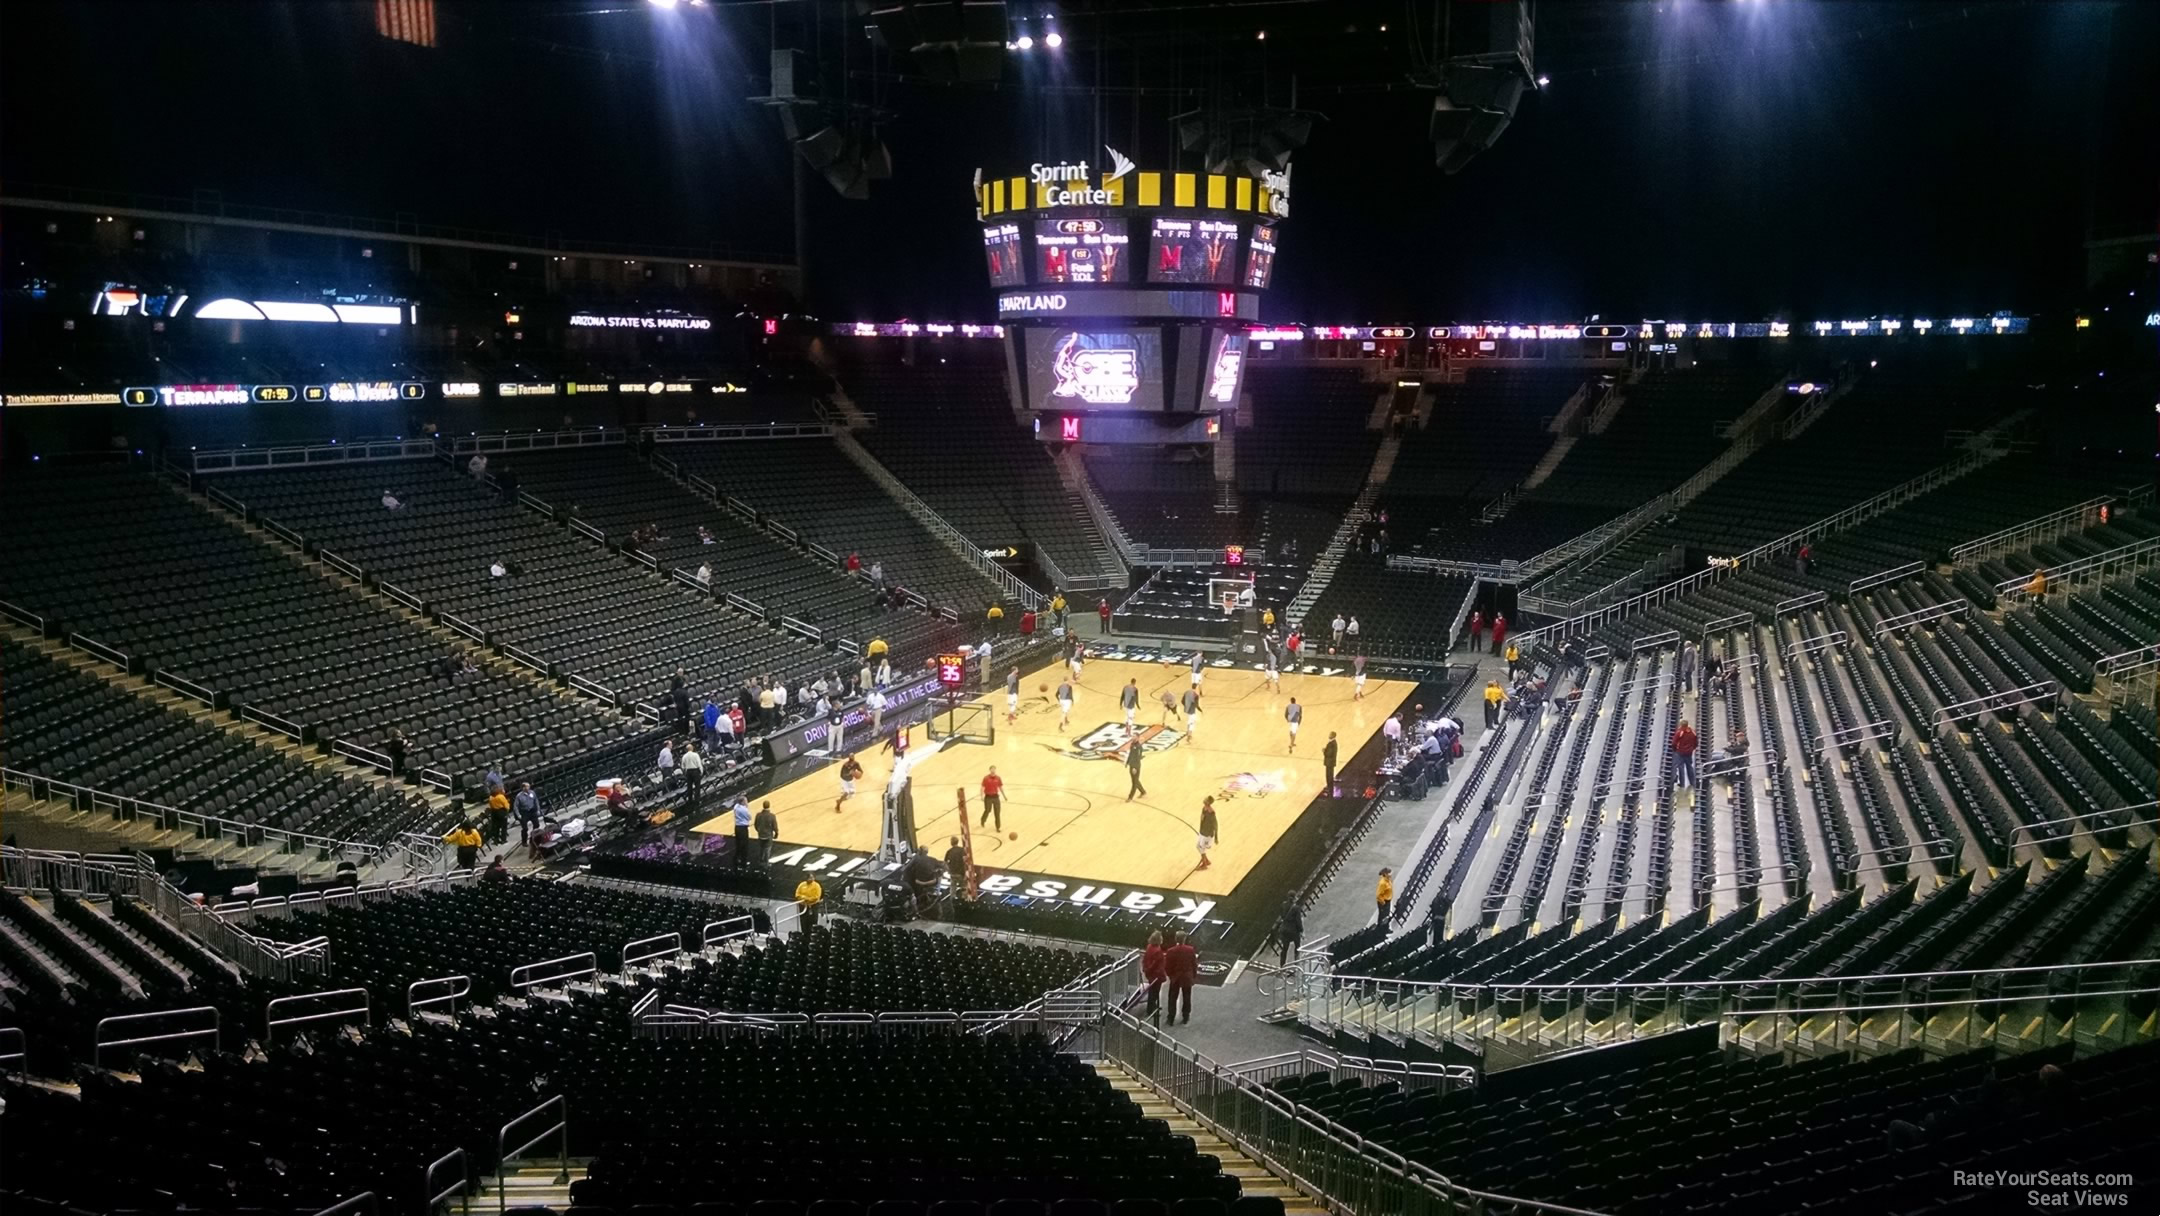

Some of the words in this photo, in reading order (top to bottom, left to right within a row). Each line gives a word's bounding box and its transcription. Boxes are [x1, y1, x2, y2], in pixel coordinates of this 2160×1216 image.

[1031, 161, 1089, 187] Sprint
[1046, 185, 1115, 206] Center
[1003, 294, 1067, 311] MARYLAND
[1221, 293, 1234, 314] M
[570, 316, 607, 327] ARIZONA
[607, 317, 640, 328] STATE
[641, 318, 657, 328] VS.
[657, 319, 711, 330] MARYLAND
[136, 391, 145, 403] 0
[261, 388, 289, 400] 47:59
[409, 386, 416, 397] 0
[518, 384, 556, 395] Farmland
[1063, 418, 1079, 437] M
[983, 549, 1007, 559] Sprint
[1707, 555, 1730, 567] Sprint
[943, 664, 960, 681] 35
[804, 723, 831, 744] DRIV
[898, 691, 909, 706] AT
[909, 687, 926, 700] THE
